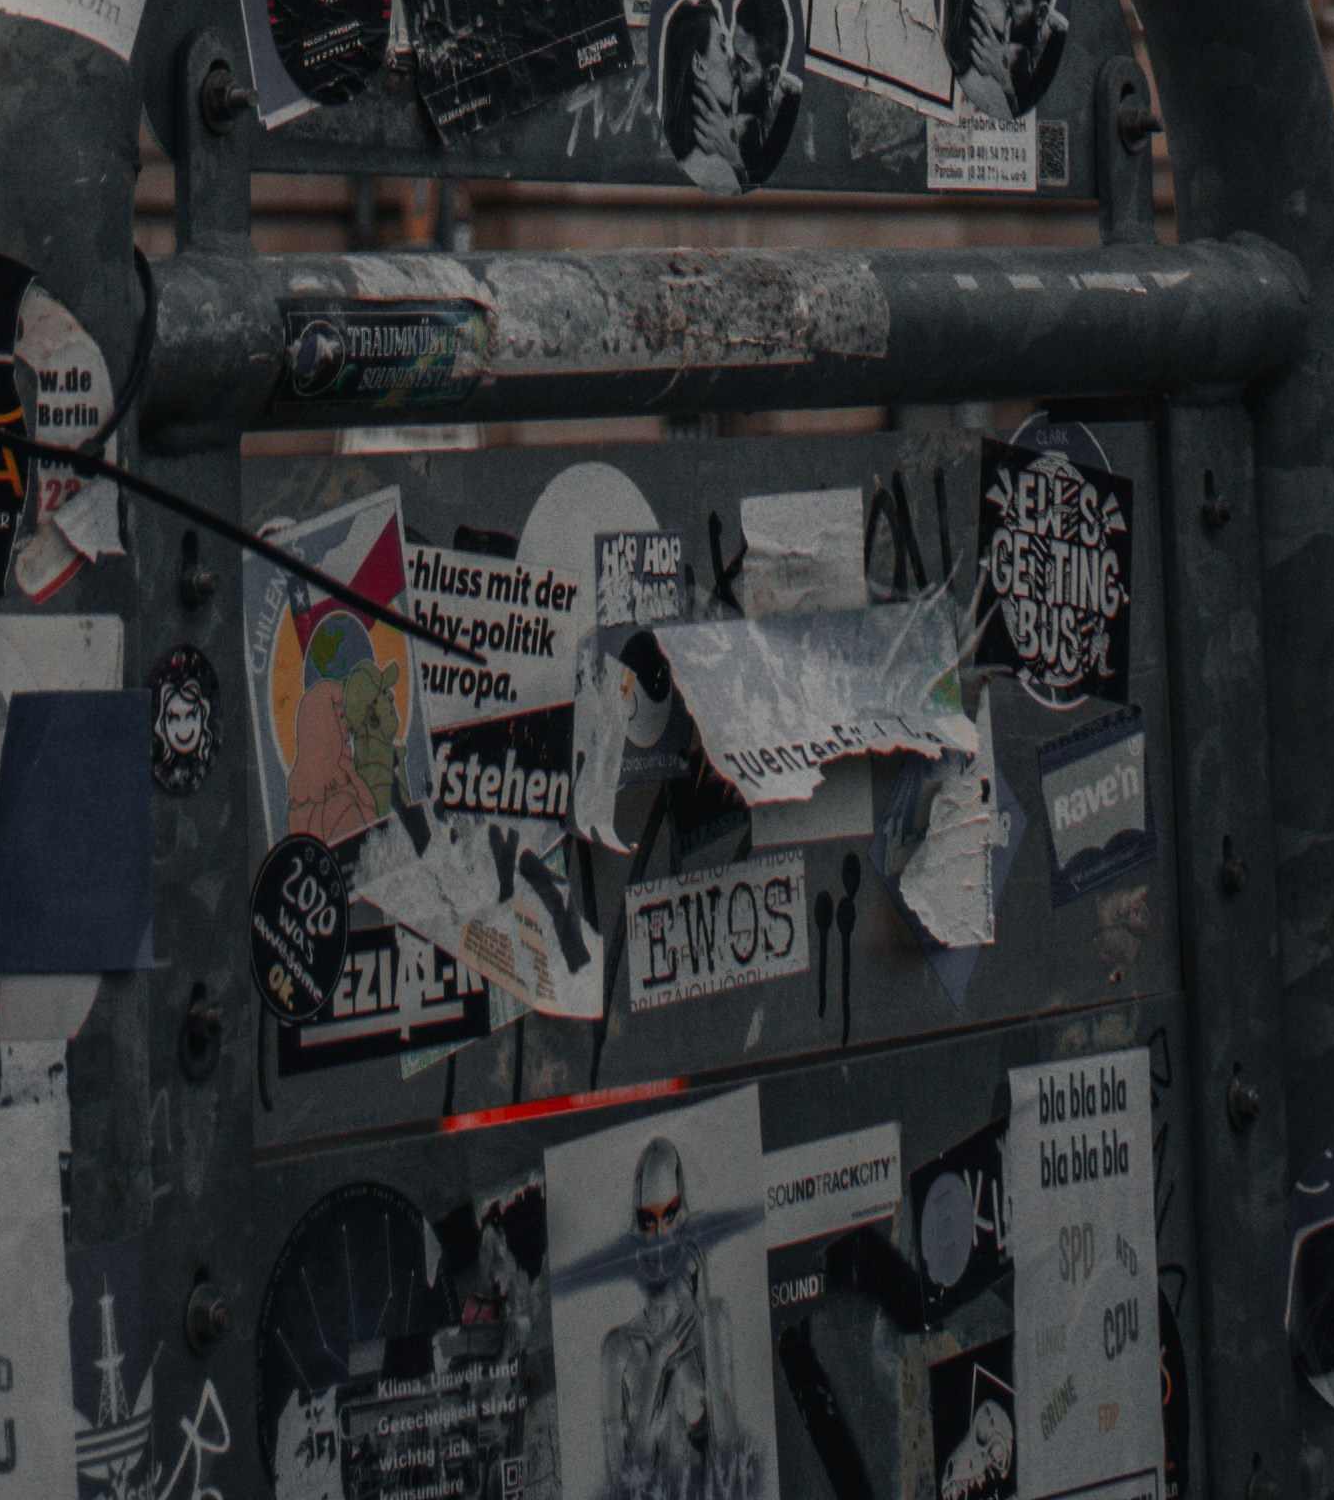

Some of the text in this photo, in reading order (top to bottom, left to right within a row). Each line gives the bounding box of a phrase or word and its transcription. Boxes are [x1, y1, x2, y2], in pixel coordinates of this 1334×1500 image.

[37, 403, 99, 428] Berlin
[1035, 427, 1069, 447] CLARK
[486, 566, 531, 604] mit
[534, 567, 577, 612] der
[282, 856, 337, 938] 2020
[253, 913, 323, 1005] awesome
[279, 903, 315, 966] was
[638, 874, 796, 989] EWOS
[1038, 1065, 1127, 1125] bla bla bla
[766, 1154, 891, 1211] SOUNDTRACKCITY
[1040, 1128, 1129, 1189] bla bla bla
[1058, 1222, 1095, 1285] SPD
[1115, 1232, 1138, 1277] AFD
[1103, 1297, 1140, 1361] CDU
[429, 1361, 484, 1389] Umwelt
[488, 1356, 519, 1379] und
[378, 1400, 478, 1438] Gerechtigkeit
[481, 1395, 516, 1417] sind
[1097, 1402, 1120, 1433] FDP
[379, 1445, 437, 1472] wichtig
[448, 1437, 472, 1460] ich
